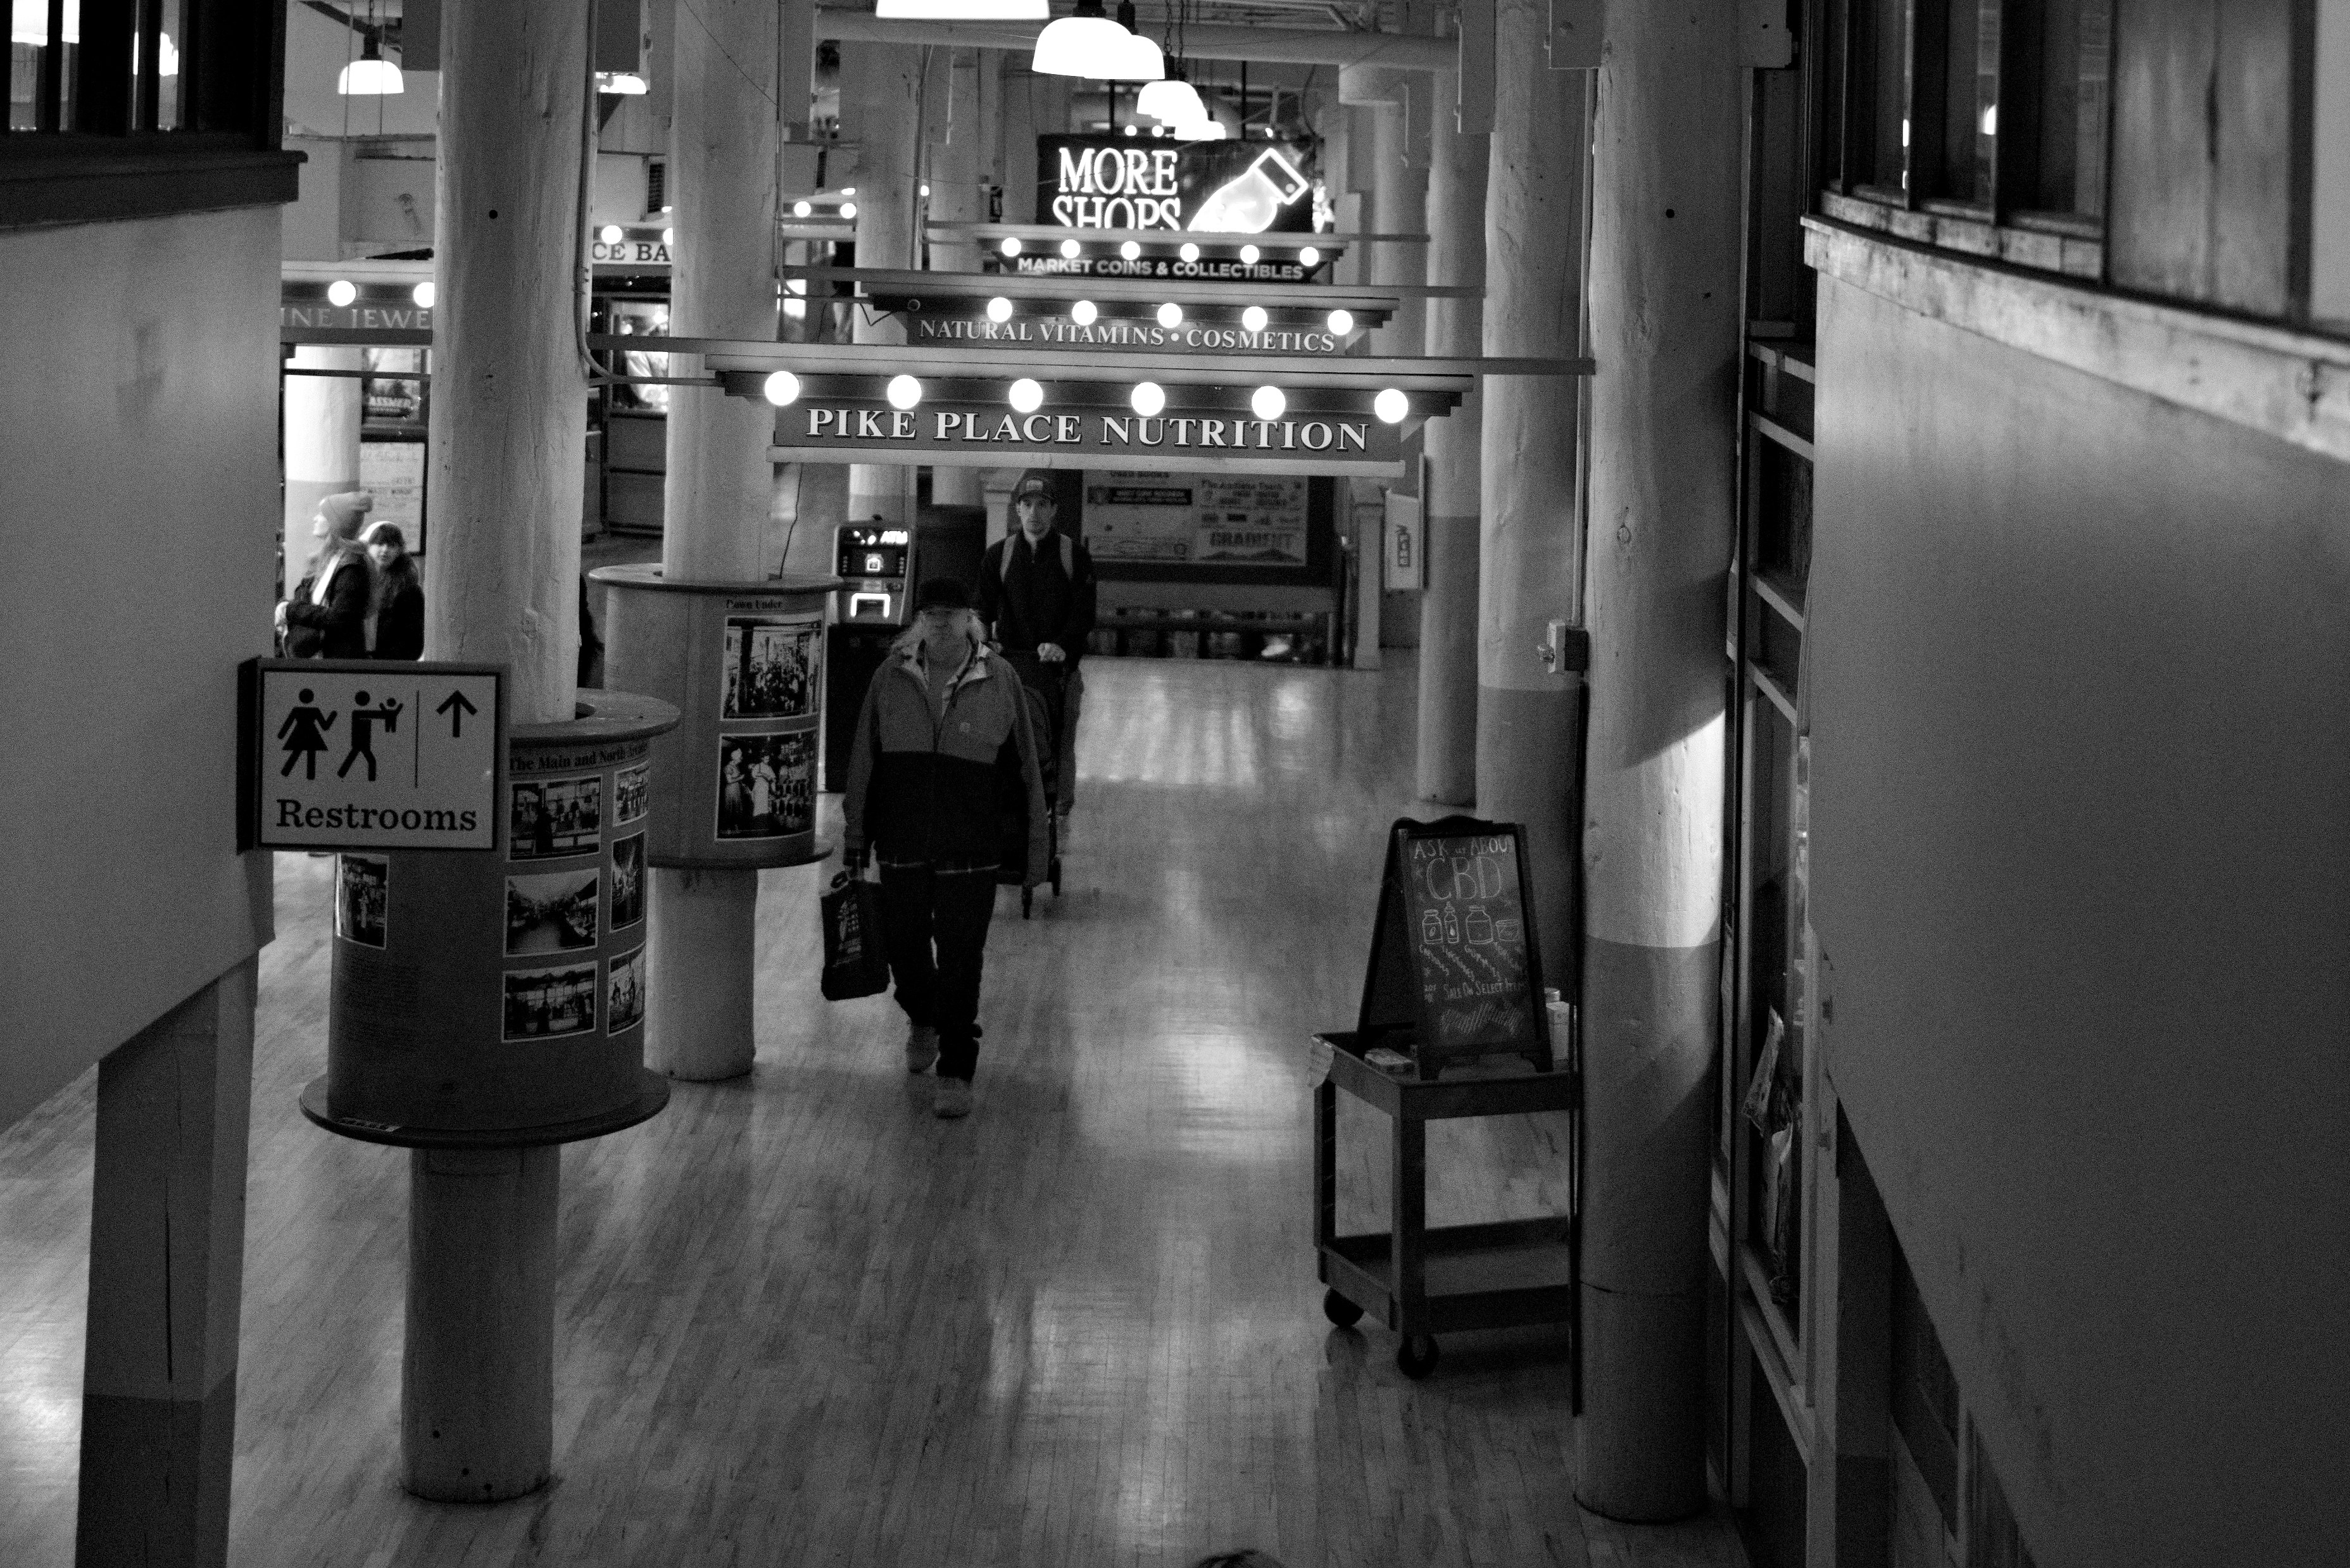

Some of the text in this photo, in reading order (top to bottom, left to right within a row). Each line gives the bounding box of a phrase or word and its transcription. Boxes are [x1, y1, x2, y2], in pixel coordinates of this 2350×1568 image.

[1058, 147, 1178, 195] MORE
[1052, 195, 1180, 231] SHOPS
[593, 242, 671, 261] CE BA
[1018, 258, 1304, 279] MARKET COINS & COLLECTIBLES
[349, 308, 431, 329] JEWE
[919, 319, 1335, 351] NATURAL VITAMINS COSMETICS
[806, 408, 1370, 452] PIKE PLACE NUTRITION
[538, 755, 571, 770] Main
[574, 751, 596, 766] and
[599, 747, 625, 763] North
[276, 799, 477, 831] Restrooms
[1413, 839, 1448, 859] ASK
[1426, 855, 1502, 900] CBD
